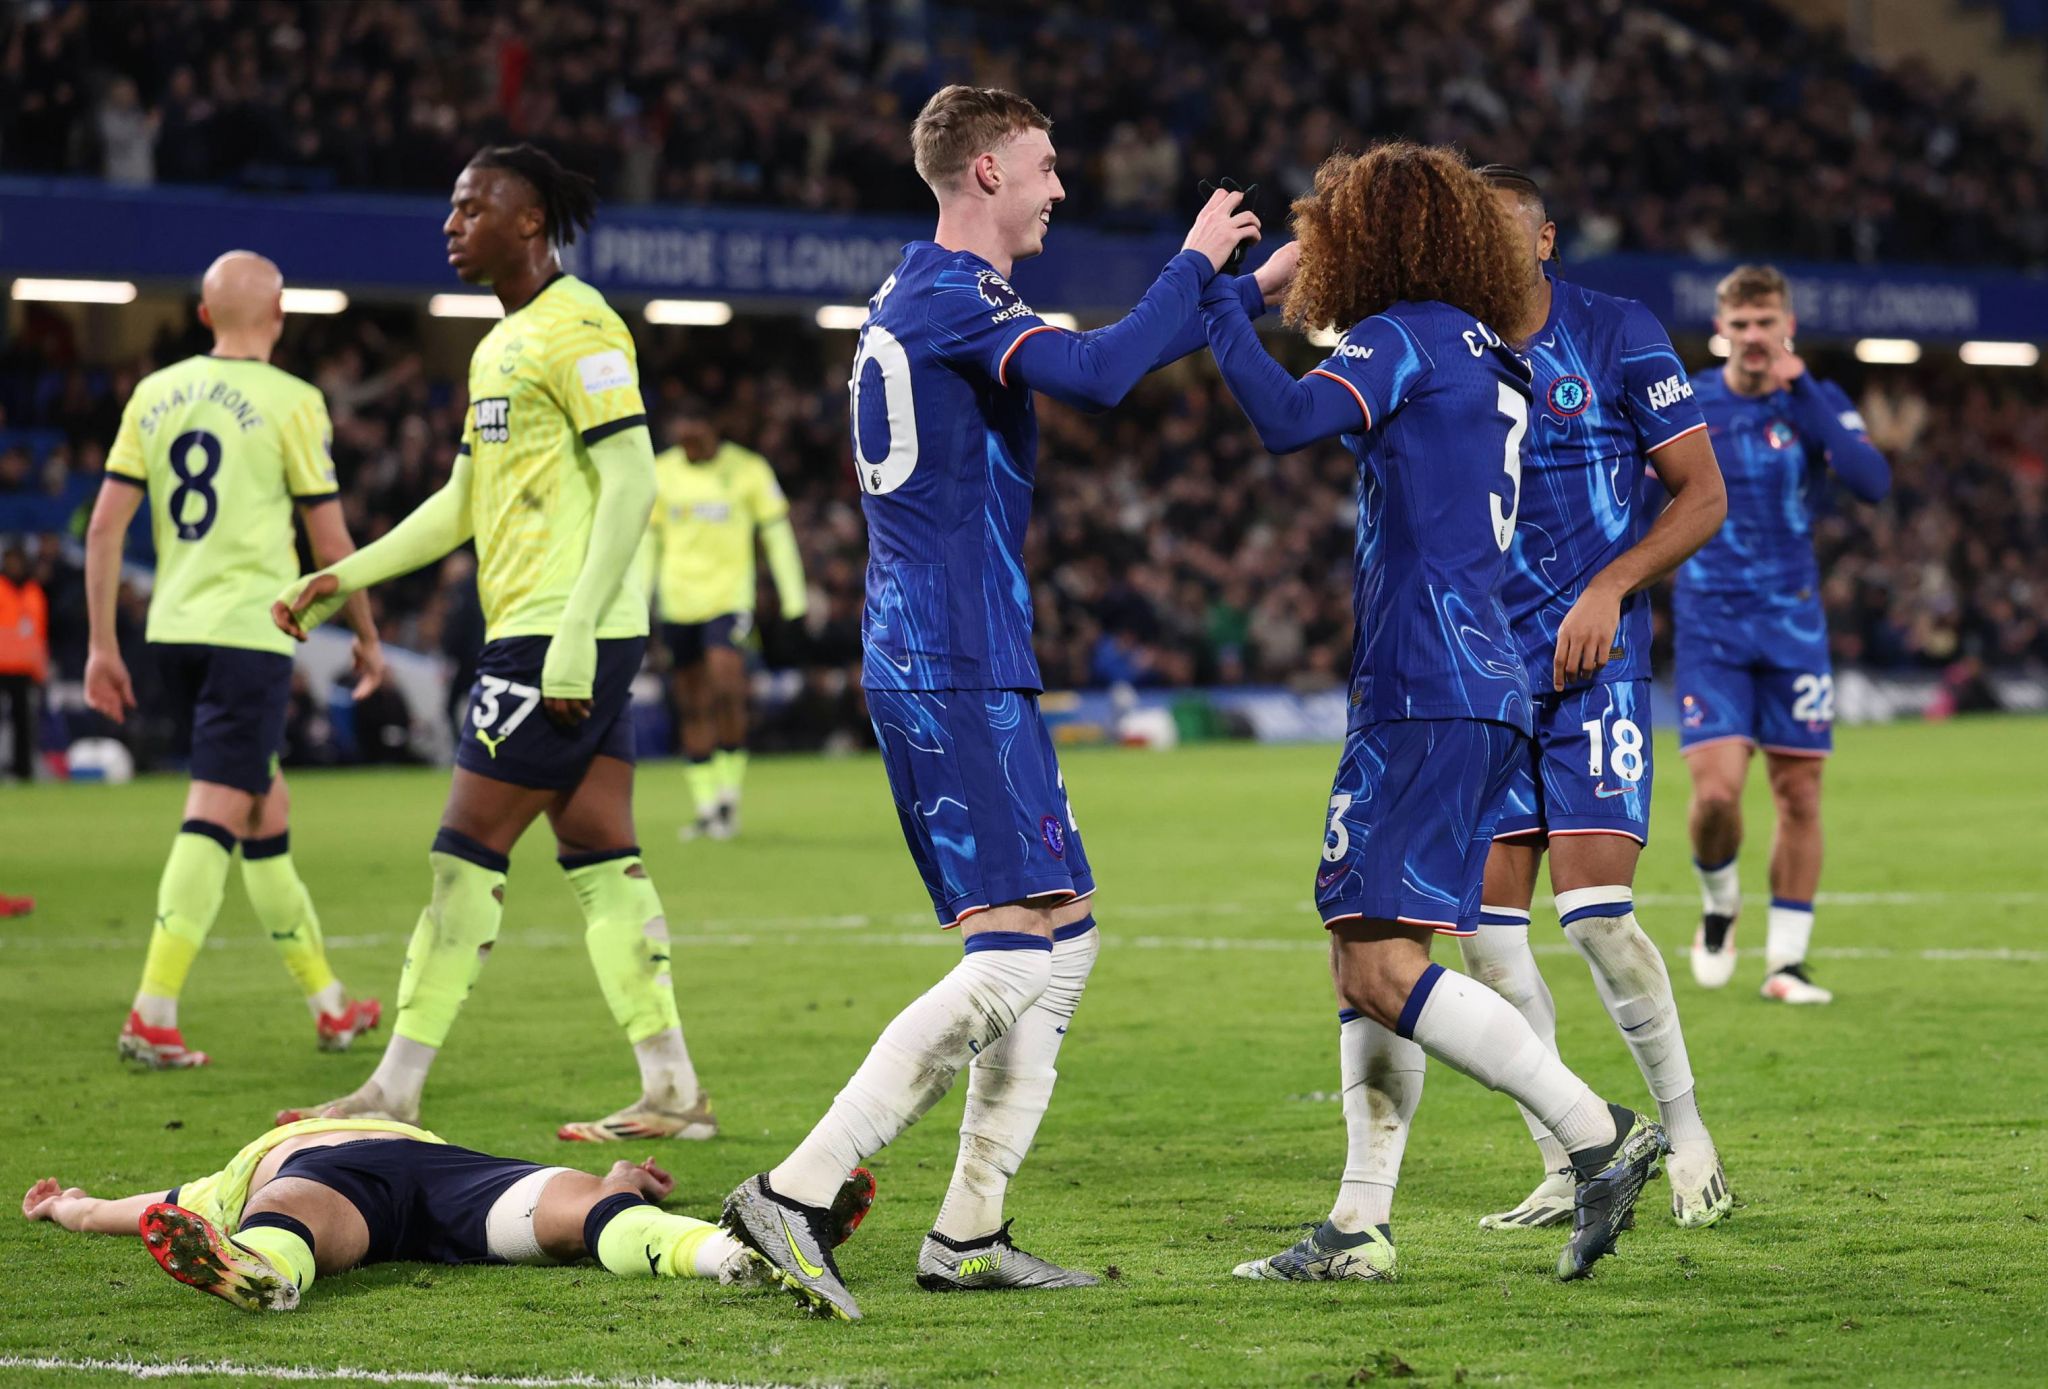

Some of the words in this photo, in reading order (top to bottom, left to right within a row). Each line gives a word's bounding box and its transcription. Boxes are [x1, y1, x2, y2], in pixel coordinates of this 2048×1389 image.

[1647, 374, 1681, 398] LIVE
[169, 430, 222, 542] 8
[1489, 380, 1528, 553] 3
[472, 674, 541, 737] 37
[1791, 673, 1836, 721] 22
[1582, 719, 1645, 782] 18
[1322, 793, 1352, 863] 3
